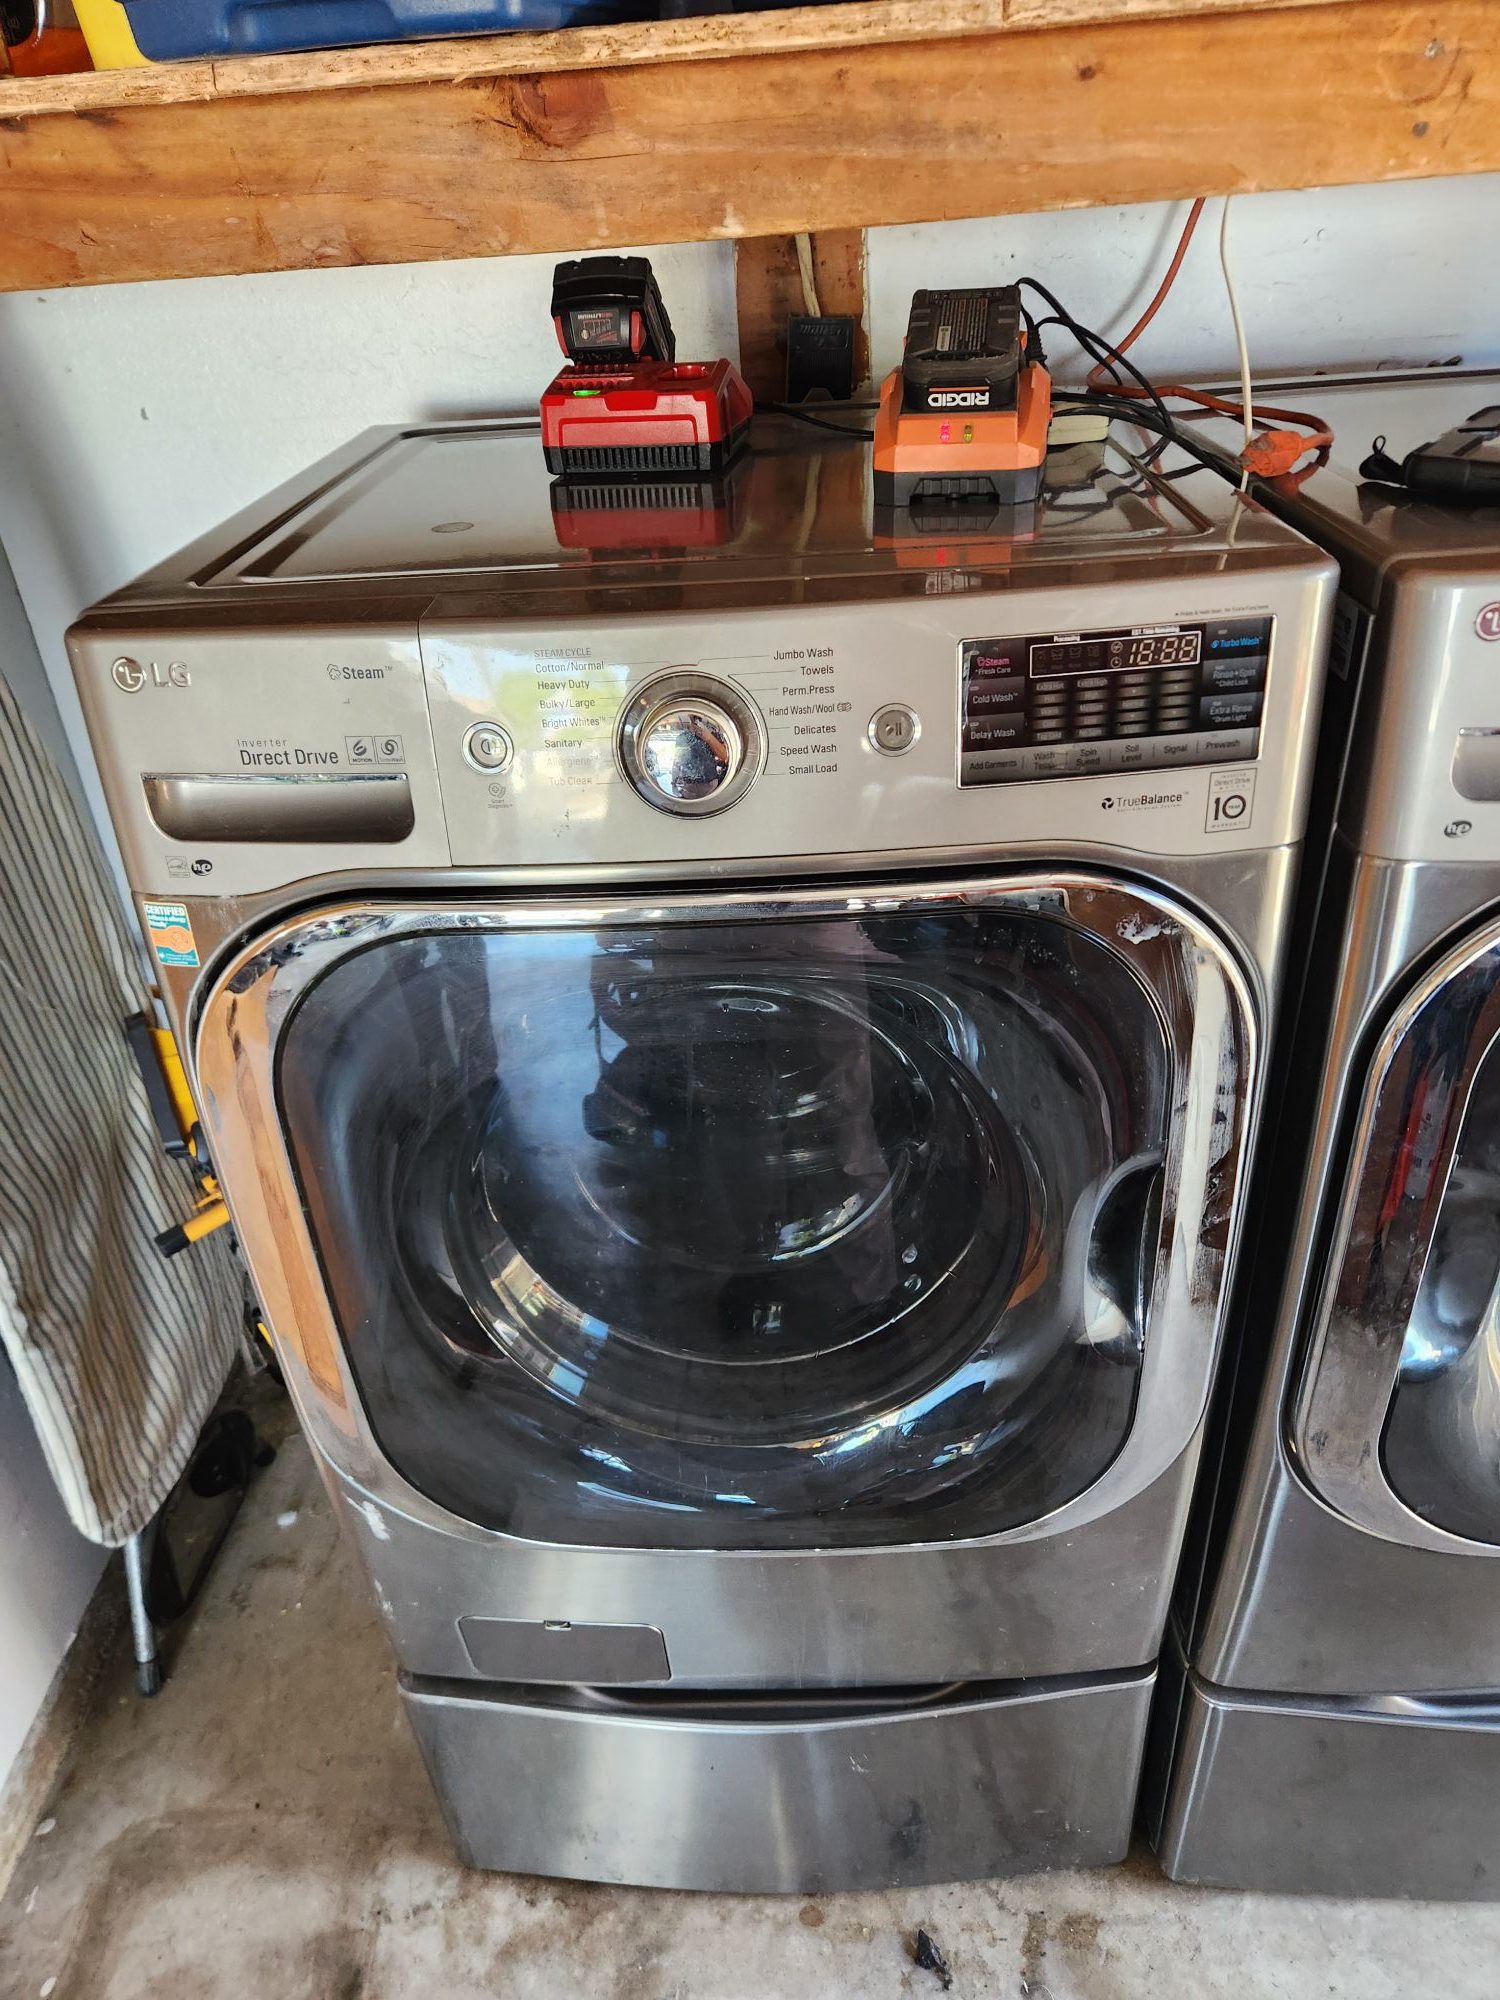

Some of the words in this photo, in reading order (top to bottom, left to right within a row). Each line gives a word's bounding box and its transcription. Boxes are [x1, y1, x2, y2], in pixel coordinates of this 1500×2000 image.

[927, 391, 990, 407] RIDGID
[534, 648, 564, 658] STEAM
[564, 647, 592, 657] CYCLE
[773, 649, 805, 660] Jumbo
[806, 647, 834, 658] Wash
[1128, 635, 1198, 666] 18:88
[535, 660, 604, 674] Cotton/Normal
[800, 664, 834, 676] Towels
[150, 661, 192, 688] LG
[537, 680, 566, 691] Heavy
[568, 679, 590, 690] Duty
[782, 684, 835, 696] Perm.Press
[539, 699, 596, 710] Bulky/Large
[972, 695, 990, 704] Cold
[769, 707, 789, 716] Hand
[790, 703, 835, 715] Wash/Wool
[542, 718, 568, 729] Bright
[793, 725, 837, 735] Delicates
[970, 731, 992, 740] Delay
[993, 728, 1016, 737] Wash
[236, 738, 288, 748] Inverter
[544, 739, 583, 749] Sanitary
[780, 745, 809, 757] Speed
[810, 743, 837, 754] Wash
[1080, 747, 1098, 757] Spin
[1163, 744, 1188, 755] Signal
[240, 749, 292, 766] Direct
[294, 748, 340, 765] Drive
[788, 764, 814, 775] Small
[815, 762, 838, 774] Load
[969, 762, 984, 771] Add
[1213, 794, 1247, 821] 10
